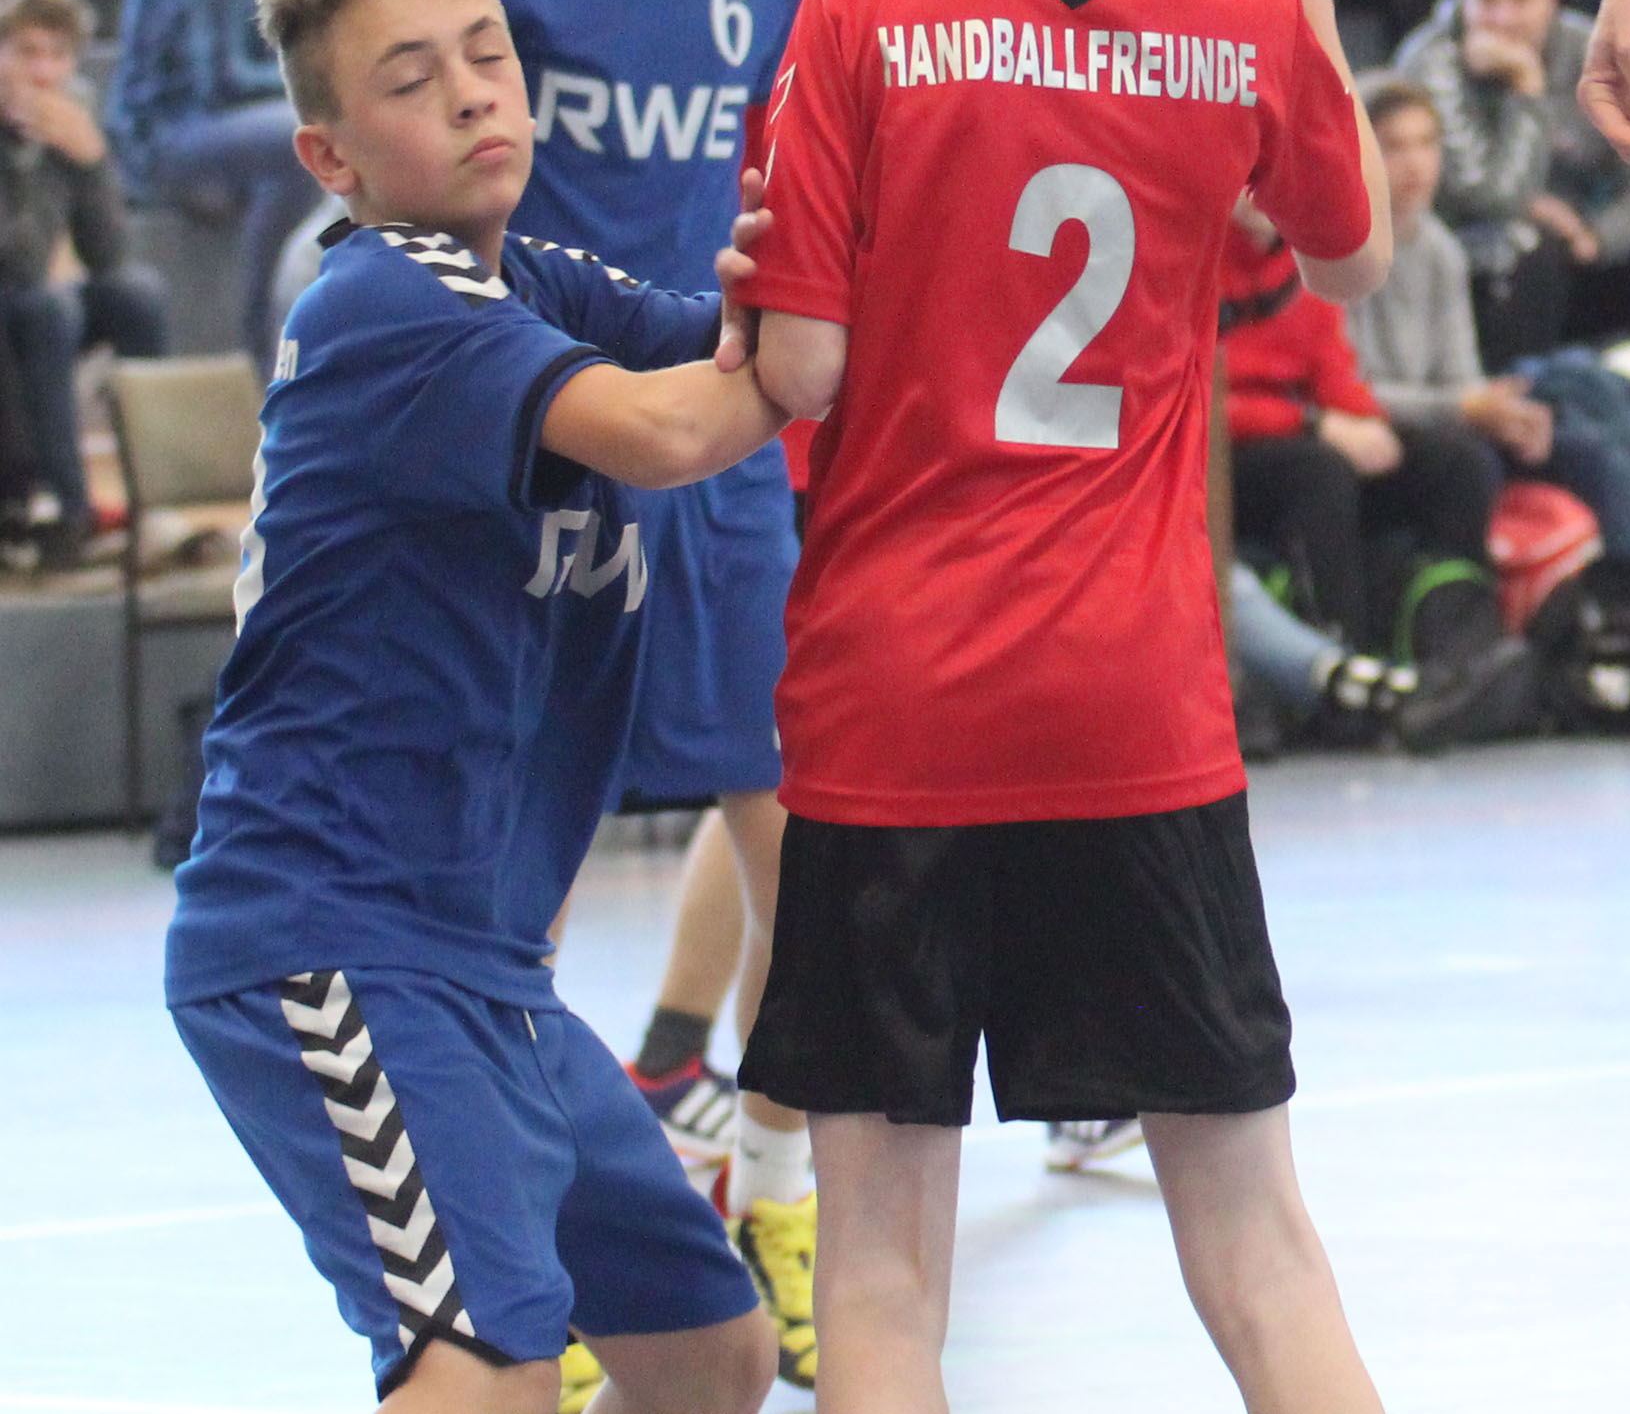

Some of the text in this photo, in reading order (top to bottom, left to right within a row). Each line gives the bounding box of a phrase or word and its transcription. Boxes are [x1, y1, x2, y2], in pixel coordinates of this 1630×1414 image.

[877, 17, 1258, 108] HANDBALLFREUNDE
[534, 68, 748, 161] RWE
[994, 162, 1136, 450] 2
